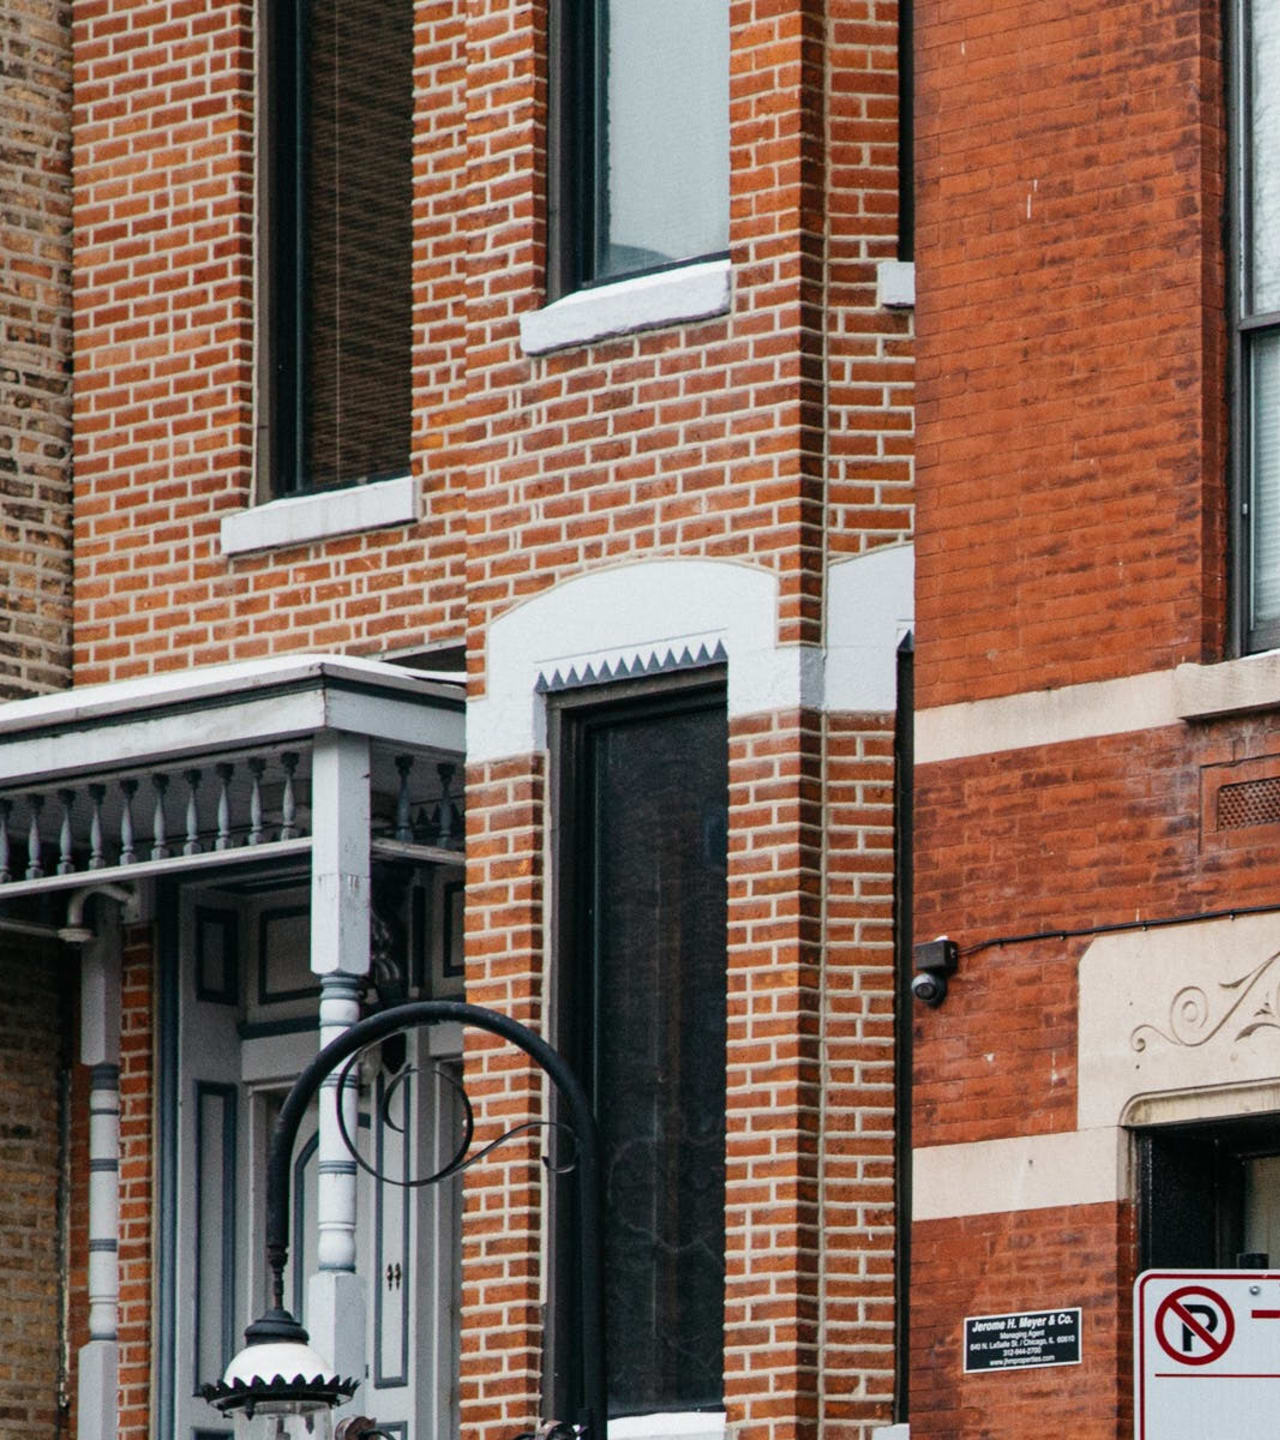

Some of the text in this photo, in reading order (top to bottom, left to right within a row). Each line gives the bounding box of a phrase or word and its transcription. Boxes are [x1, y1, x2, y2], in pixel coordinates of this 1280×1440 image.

[972, 1314, 1072, 1332] Jerome H. Meyer & Co.
[1028, 1330, 1044, 1338] Agent
